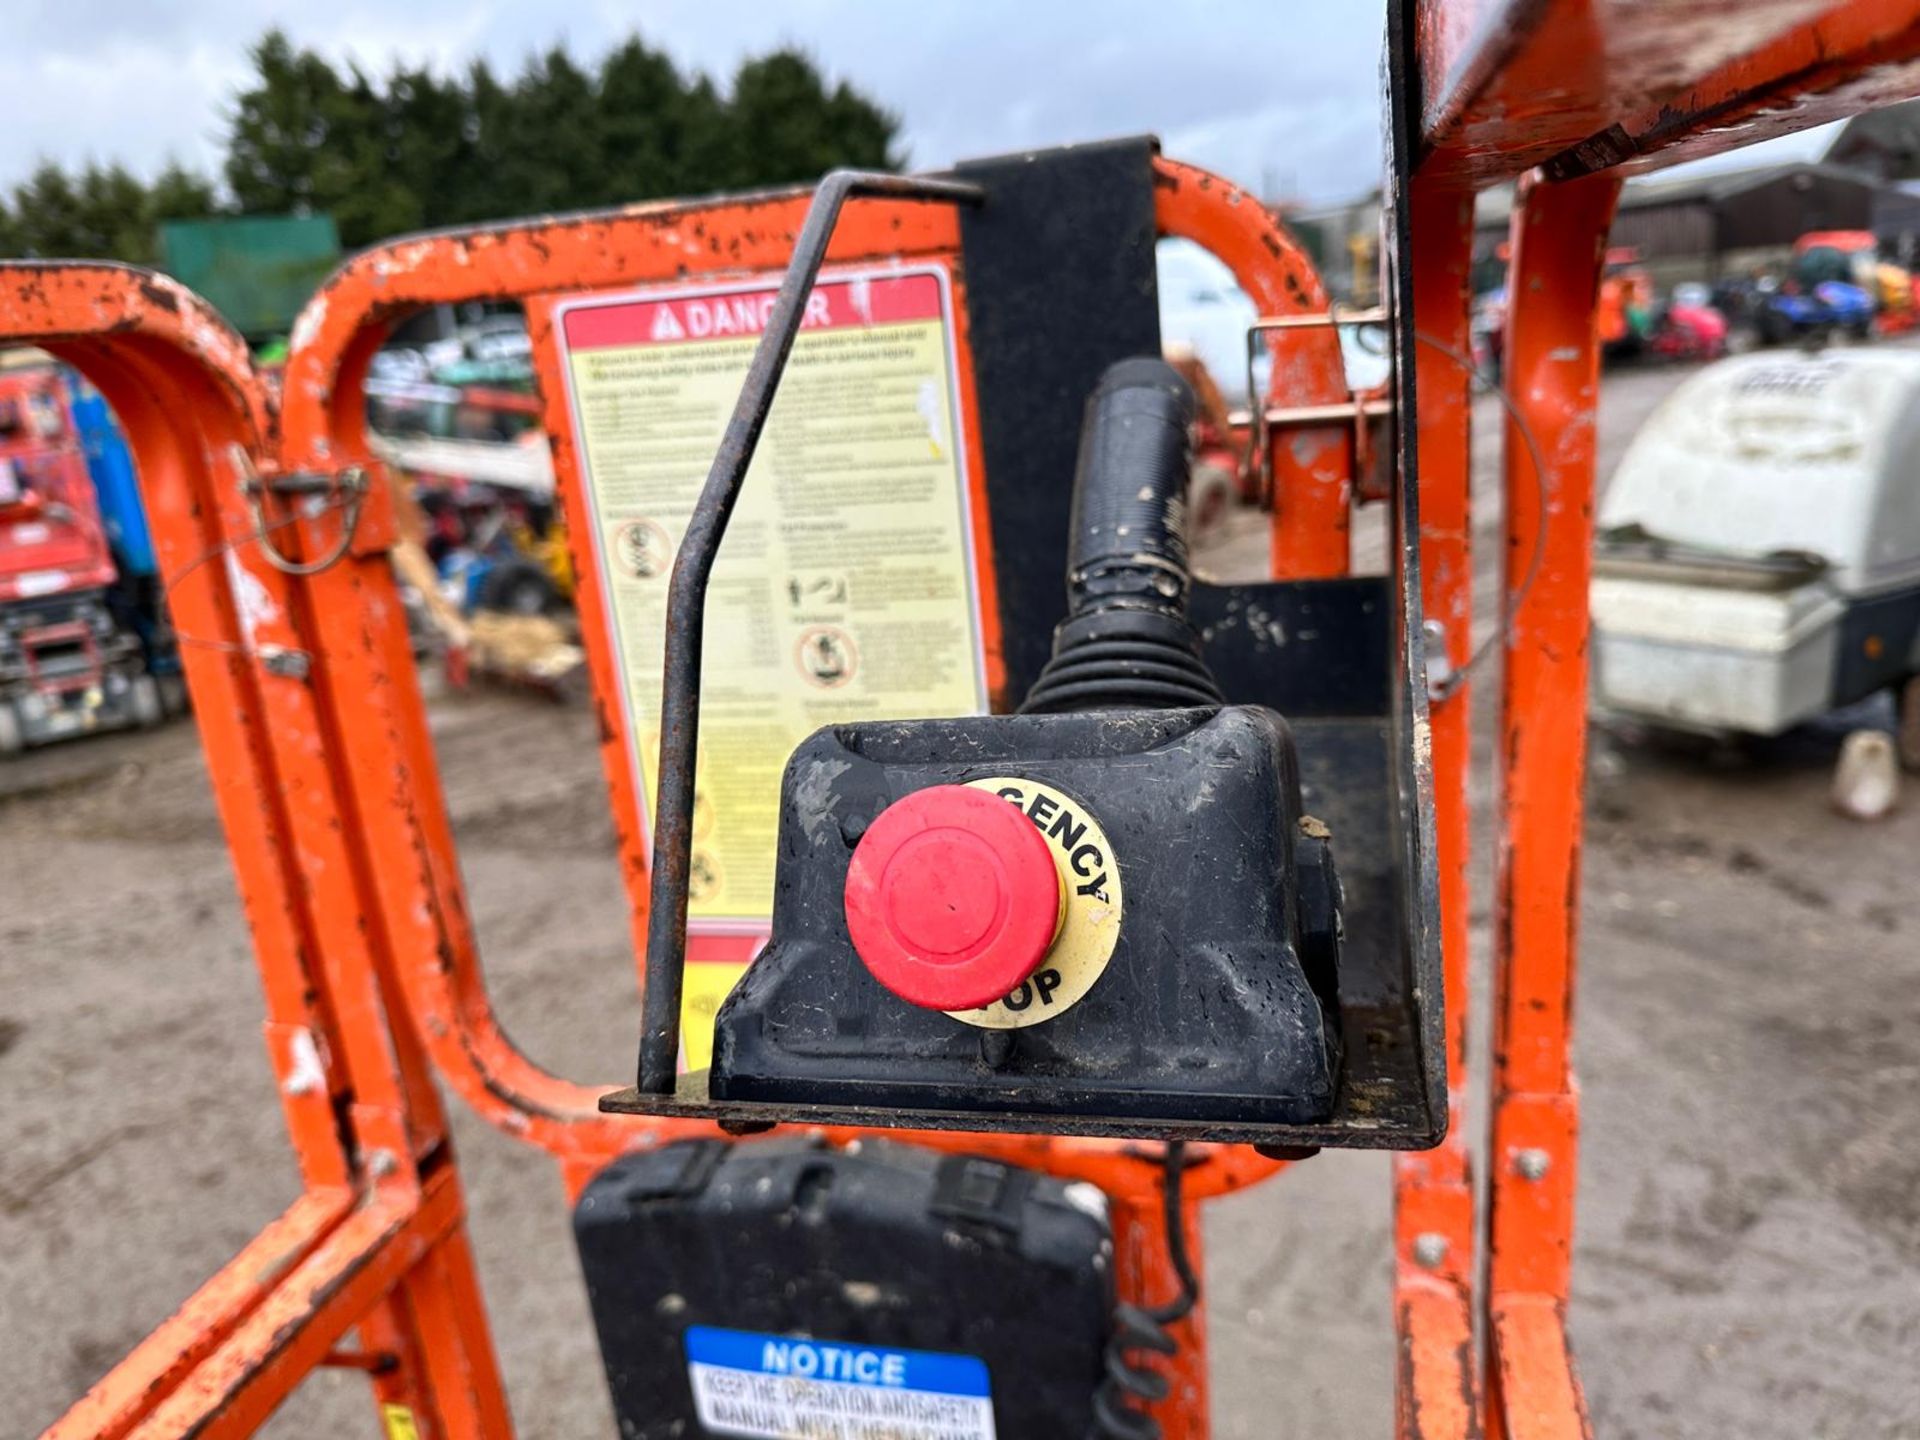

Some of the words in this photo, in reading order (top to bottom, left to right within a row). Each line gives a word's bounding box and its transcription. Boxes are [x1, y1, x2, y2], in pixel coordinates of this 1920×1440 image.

[686, 290, 832, 338] DANR
[976, 968, 1061, 1012] OP
[762, 1341, 907, 1385] NOTICE
